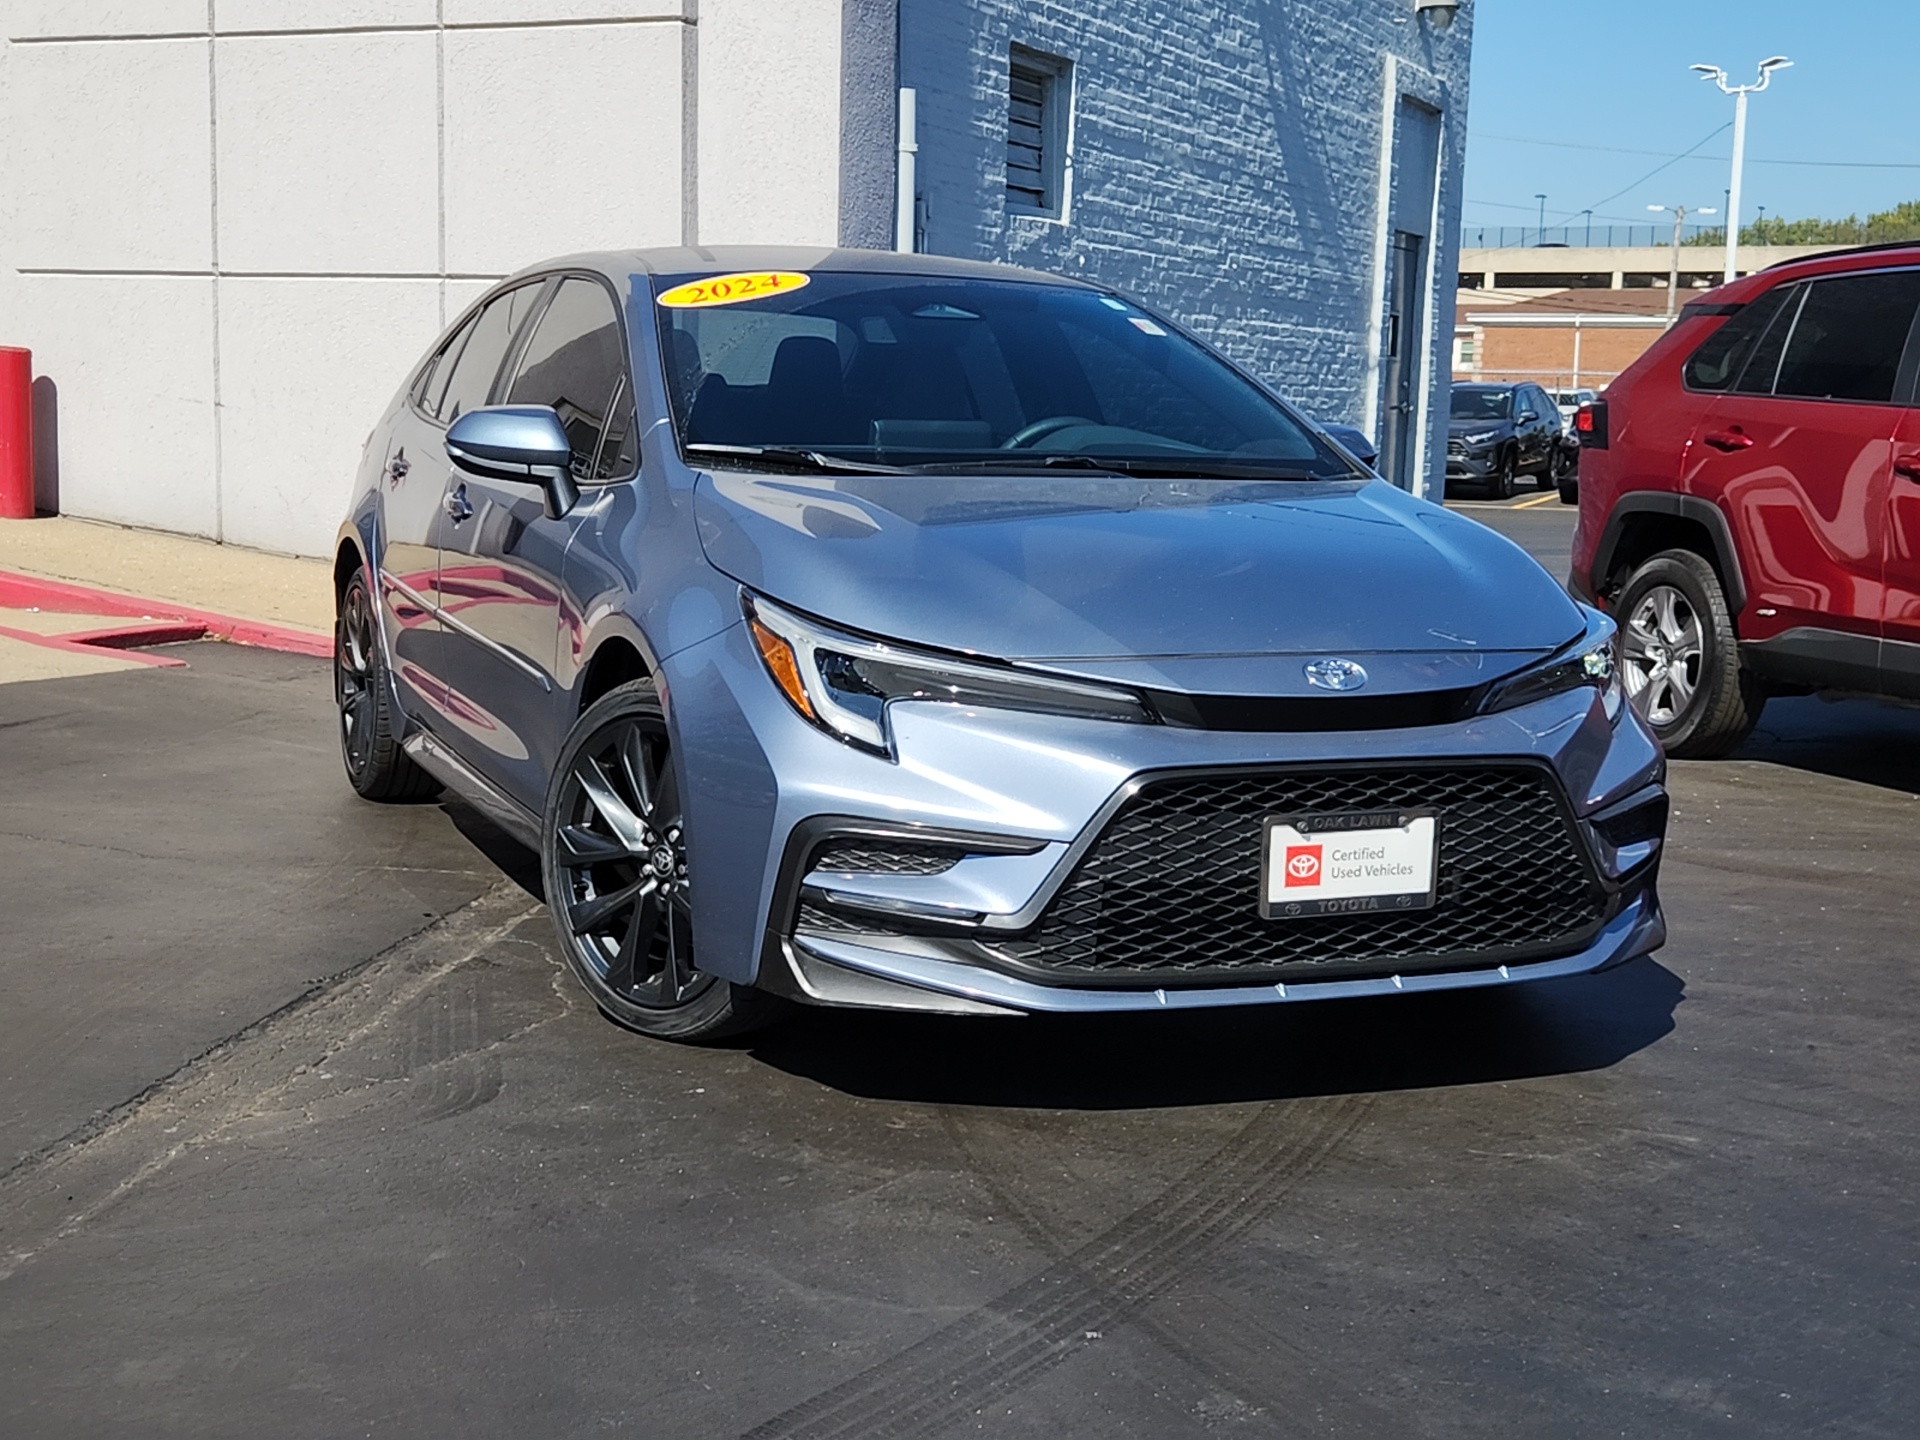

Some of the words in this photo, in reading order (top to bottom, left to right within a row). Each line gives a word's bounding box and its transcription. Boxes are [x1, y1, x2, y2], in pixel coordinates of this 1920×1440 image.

[687, 274, 781, 304] 2024
[1314, 816, 1345, 829] OAK
[1350, 814, 1392, 827] LAWN
[1332, 847, 1385, 861] Certified
[1331, 865, 1361, 879] Used
[1364, 863, 1413, 877] Vehicles
[1318, 898, 1379, 912] TOYOTA
